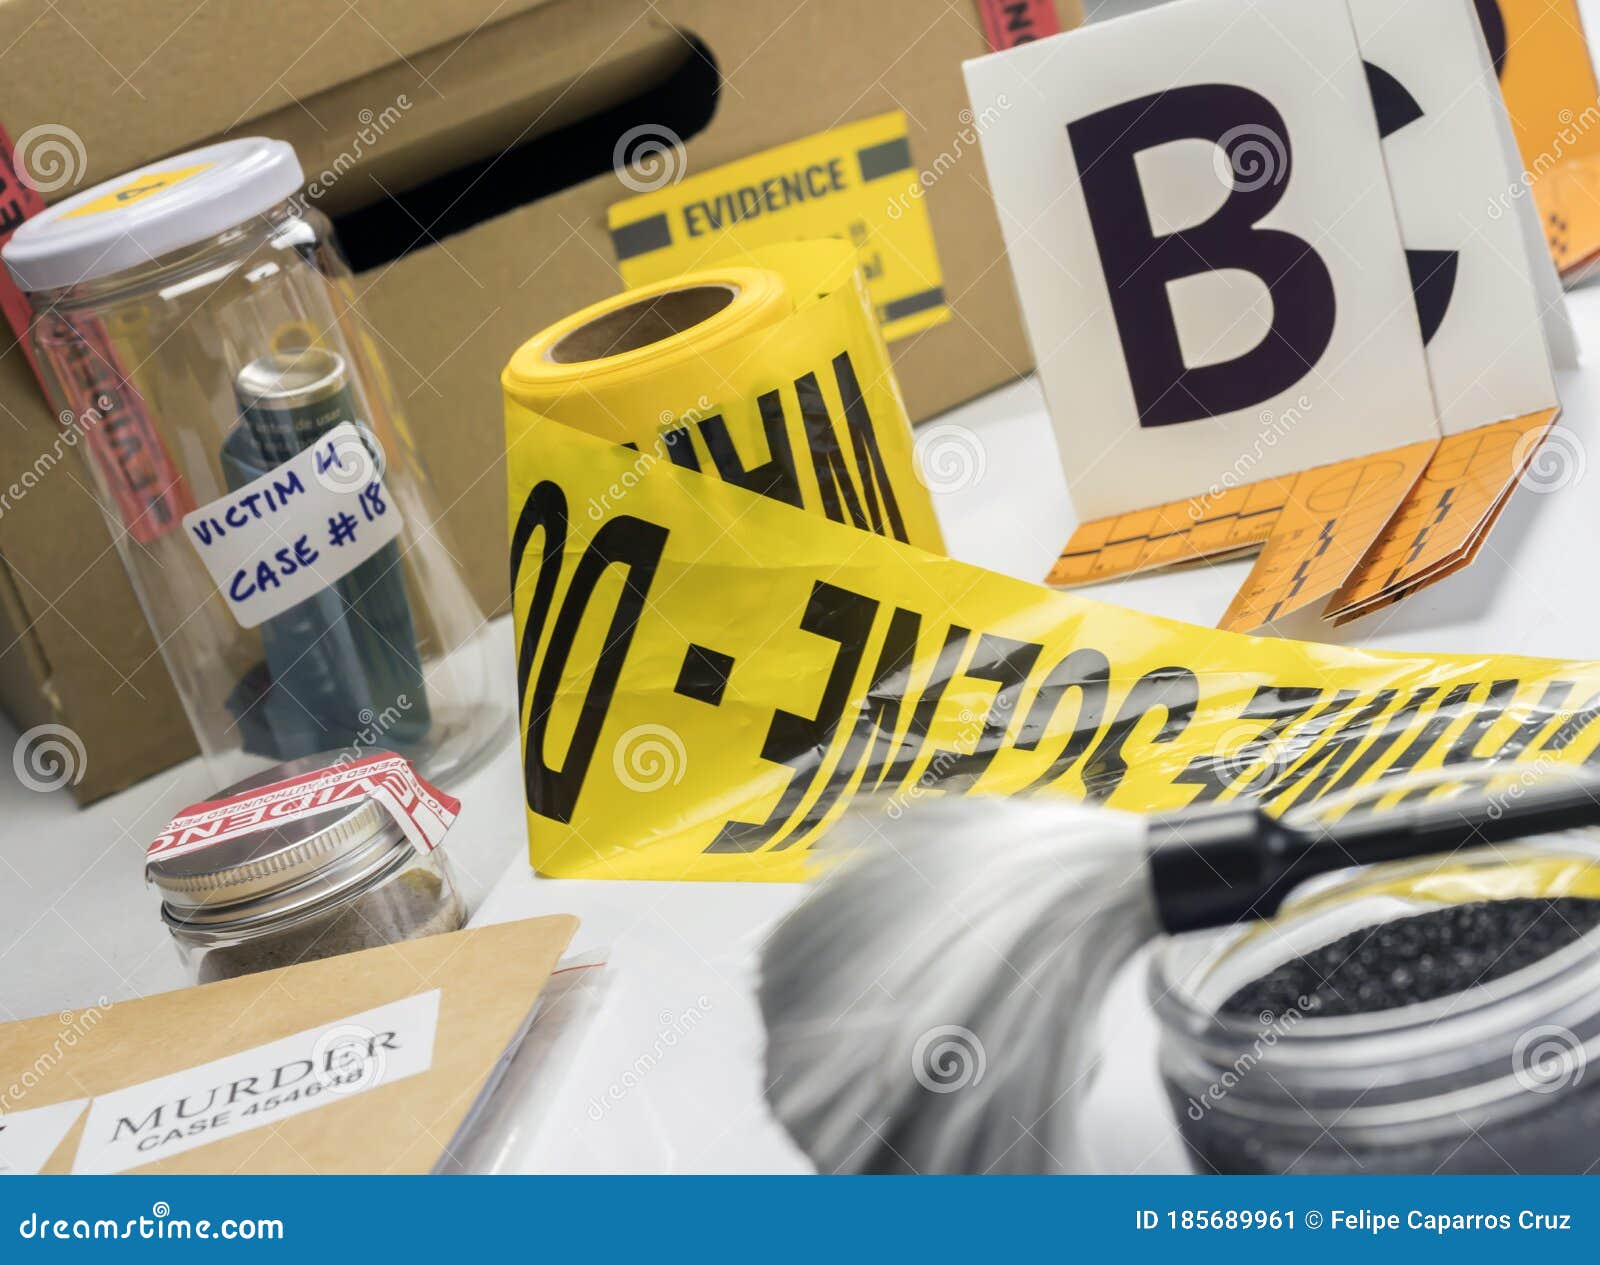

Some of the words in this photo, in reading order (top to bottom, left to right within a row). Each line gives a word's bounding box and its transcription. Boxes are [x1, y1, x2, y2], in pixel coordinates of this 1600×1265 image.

[683, 158, 847, 237] EVIDENCE
[1065, 83, 1336, 429] B
[192, 470, 305, 546] VICTIM
[229, 534, 320, 602] CASE
[109, 1031, 402, 1143] MURDER
[136, 1110, 232, 1153] CASE
